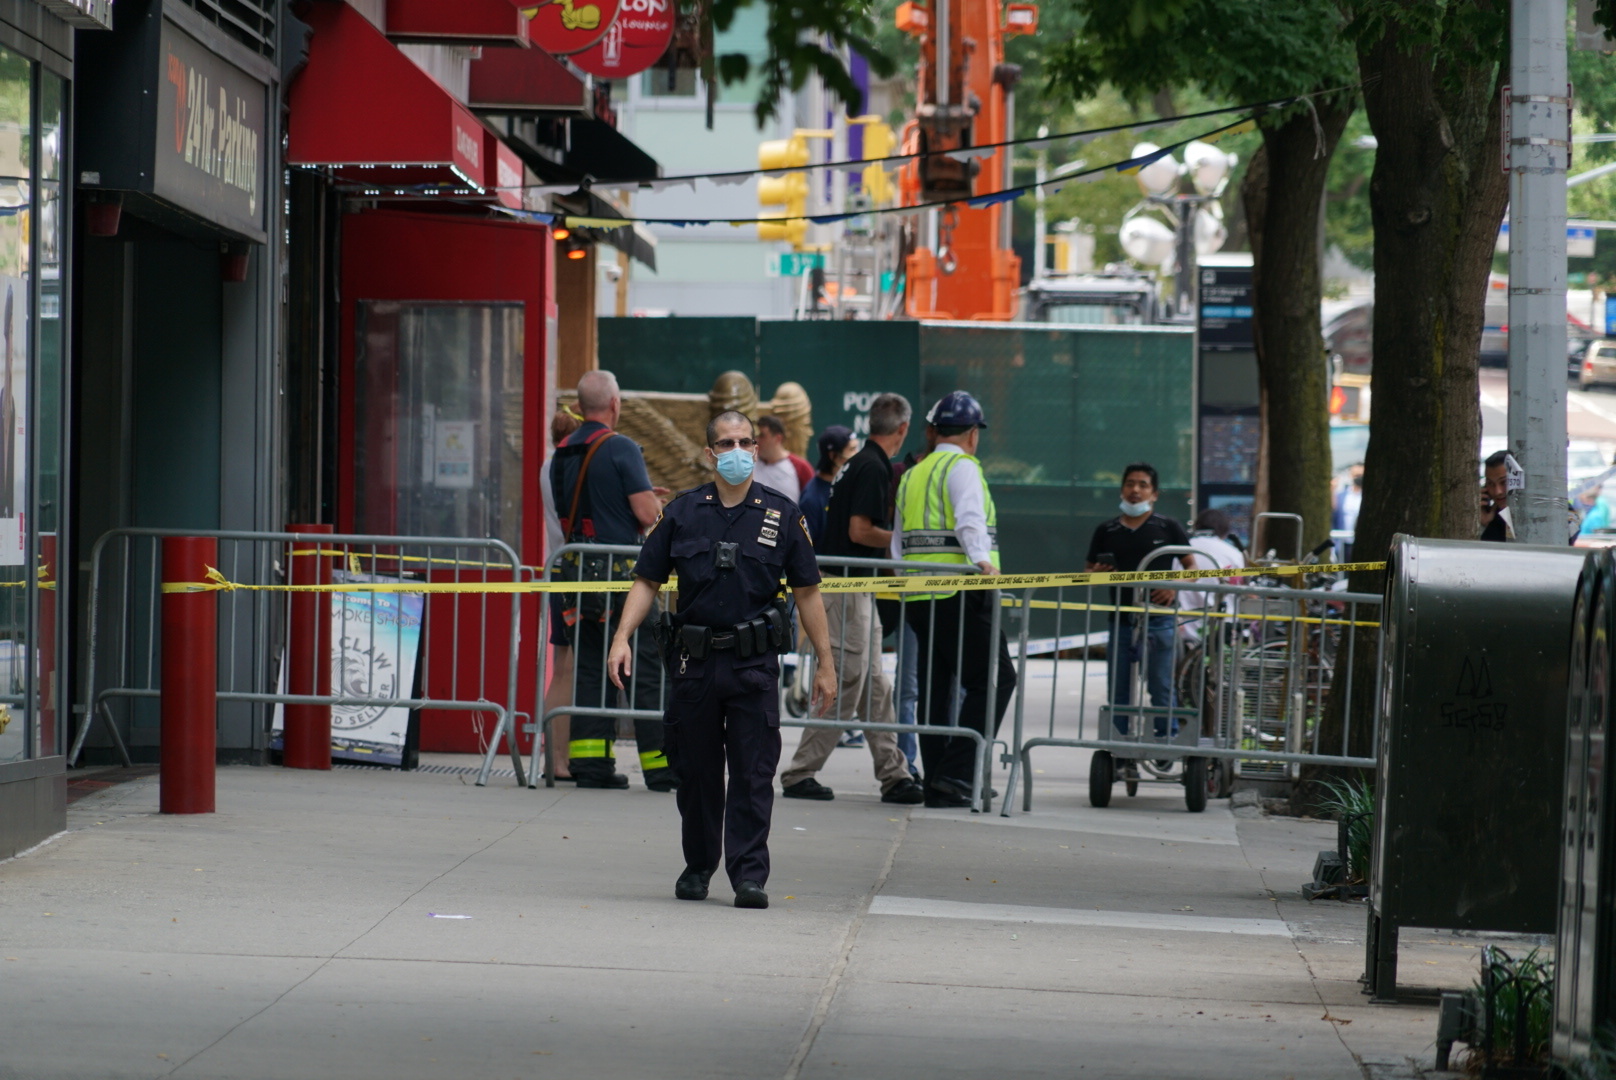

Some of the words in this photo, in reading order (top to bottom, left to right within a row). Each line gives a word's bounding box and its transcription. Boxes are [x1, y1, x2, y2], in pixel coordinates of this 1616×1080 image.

[185, 66, 202, 168] 24
[217, 86, 258, 217] Parking
[844, 391, 881, 412] PO
[854, 414, 870, 434] N
[1109, 573, 1125, 581] CROSS
[332, 593, 372, 606] elcome
[377, 597, 391, 608] To
[331, 607, 372, 624] MOKE
[376, 611, 419, 628] SHOP
[339, 636, 392, 671] CLAW
[349, 683, 390, 725] SELTER
